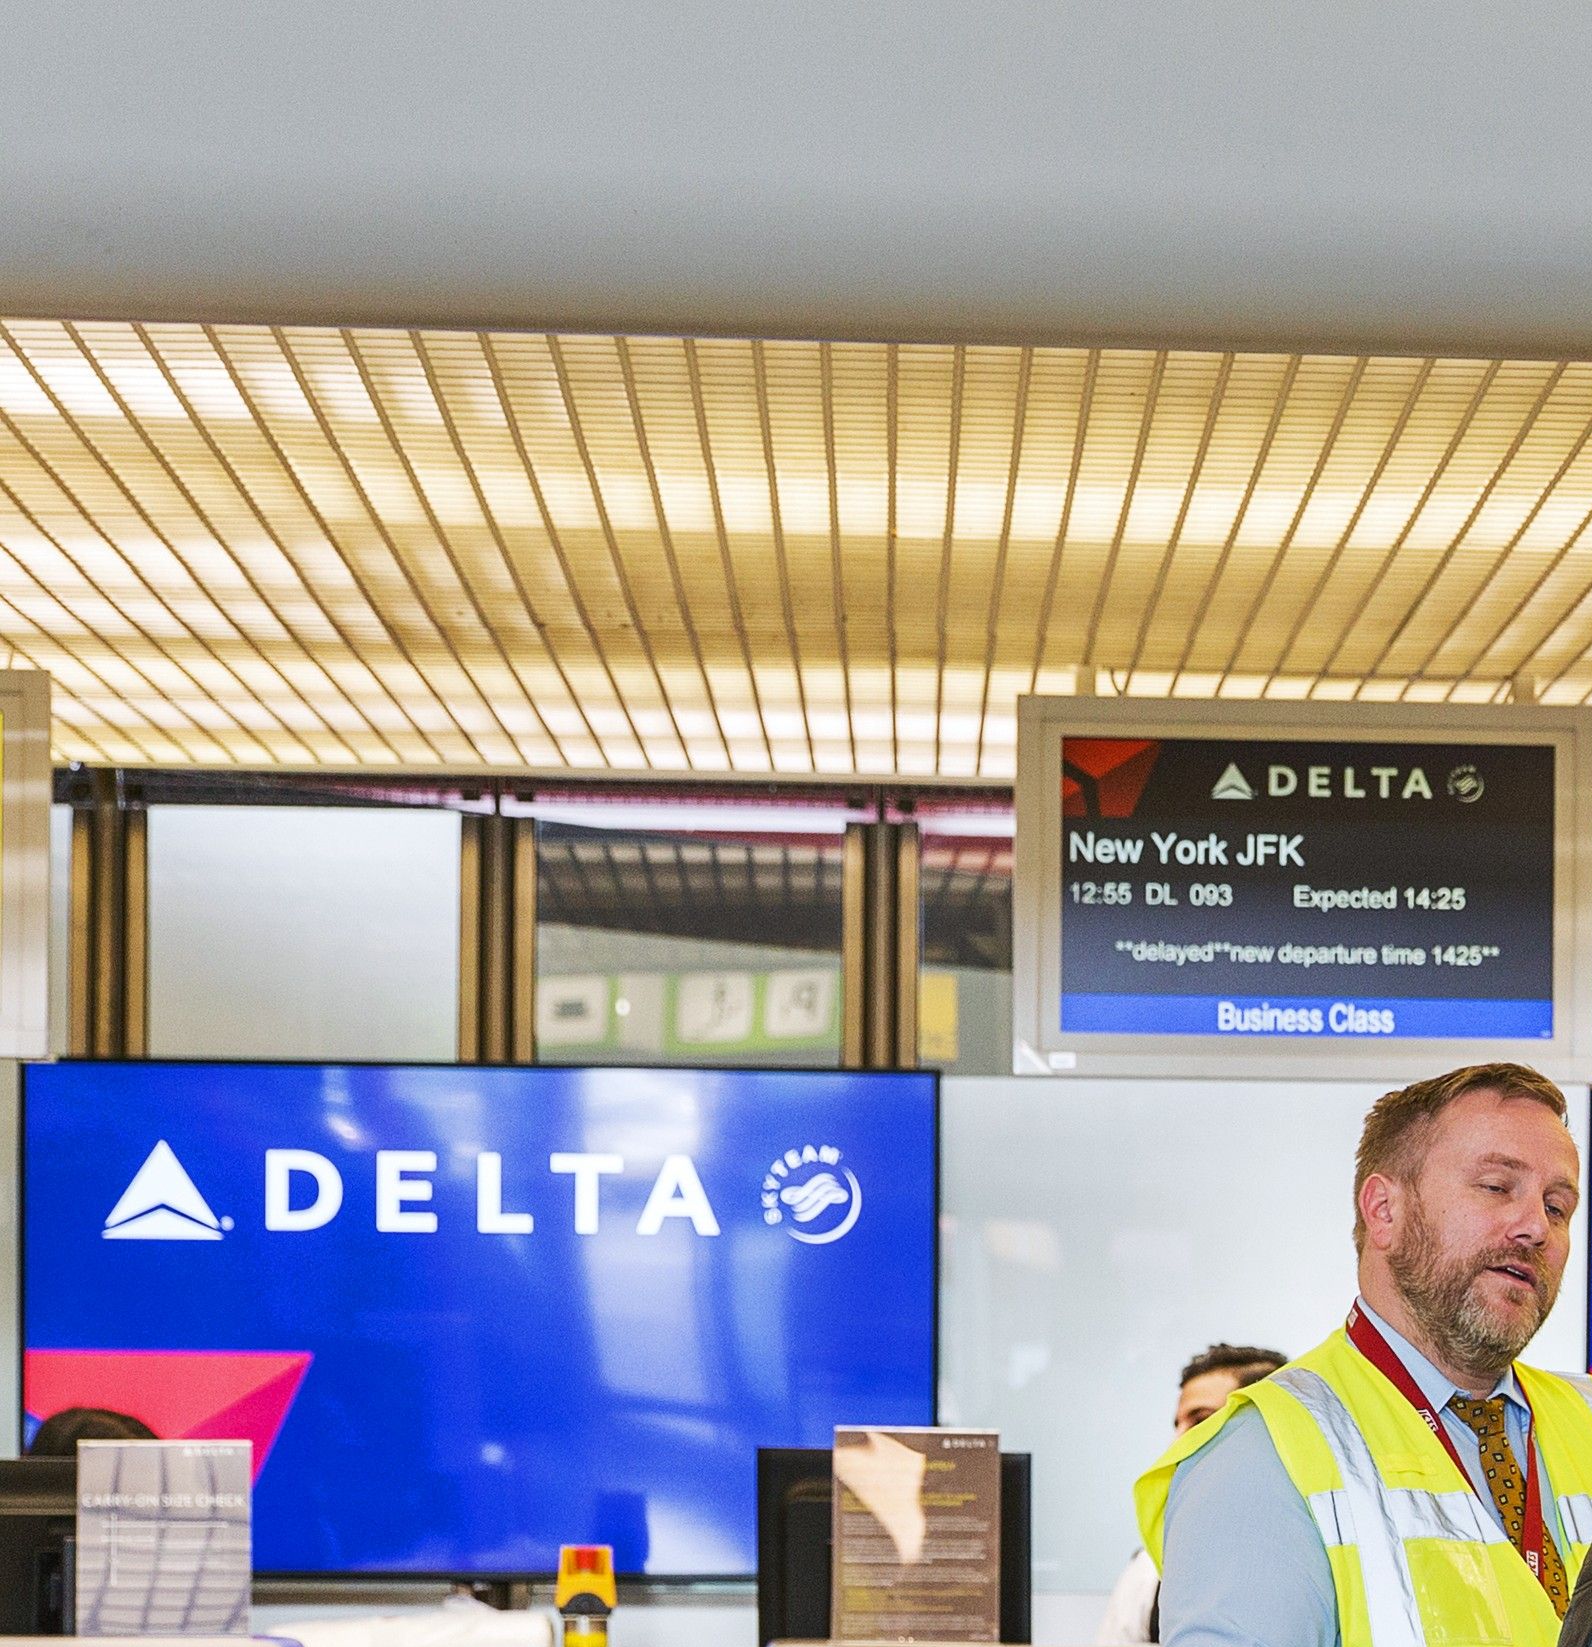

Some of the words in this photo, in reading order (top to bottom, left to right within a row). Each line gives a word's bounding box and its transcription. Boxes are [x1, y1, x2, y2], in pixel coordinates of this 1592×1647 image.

[1268, 765, 1433, 800] DELTA
[1069, 831, 1143, 865] New
[1151, 832, 1227, 866] York
[1236, 834, 1305, 867] JFK
[1070, 881, 1133, 906] 12:55
[1145, 882, 1178, 906] DL
[1189, 883, 1234, 907] 093
[1293, 884, 1397, 913] Expected
[1403, 887, 1466, 910] 14:25
[1278, 941, 1378, 968] departure
[1382, 943, 1426, 966] time
[1217, 1001, 1325, 1033] Business
[1329, 1003, 1395, 1034] Class
[264, 1148, 722, 1238] DELTA
